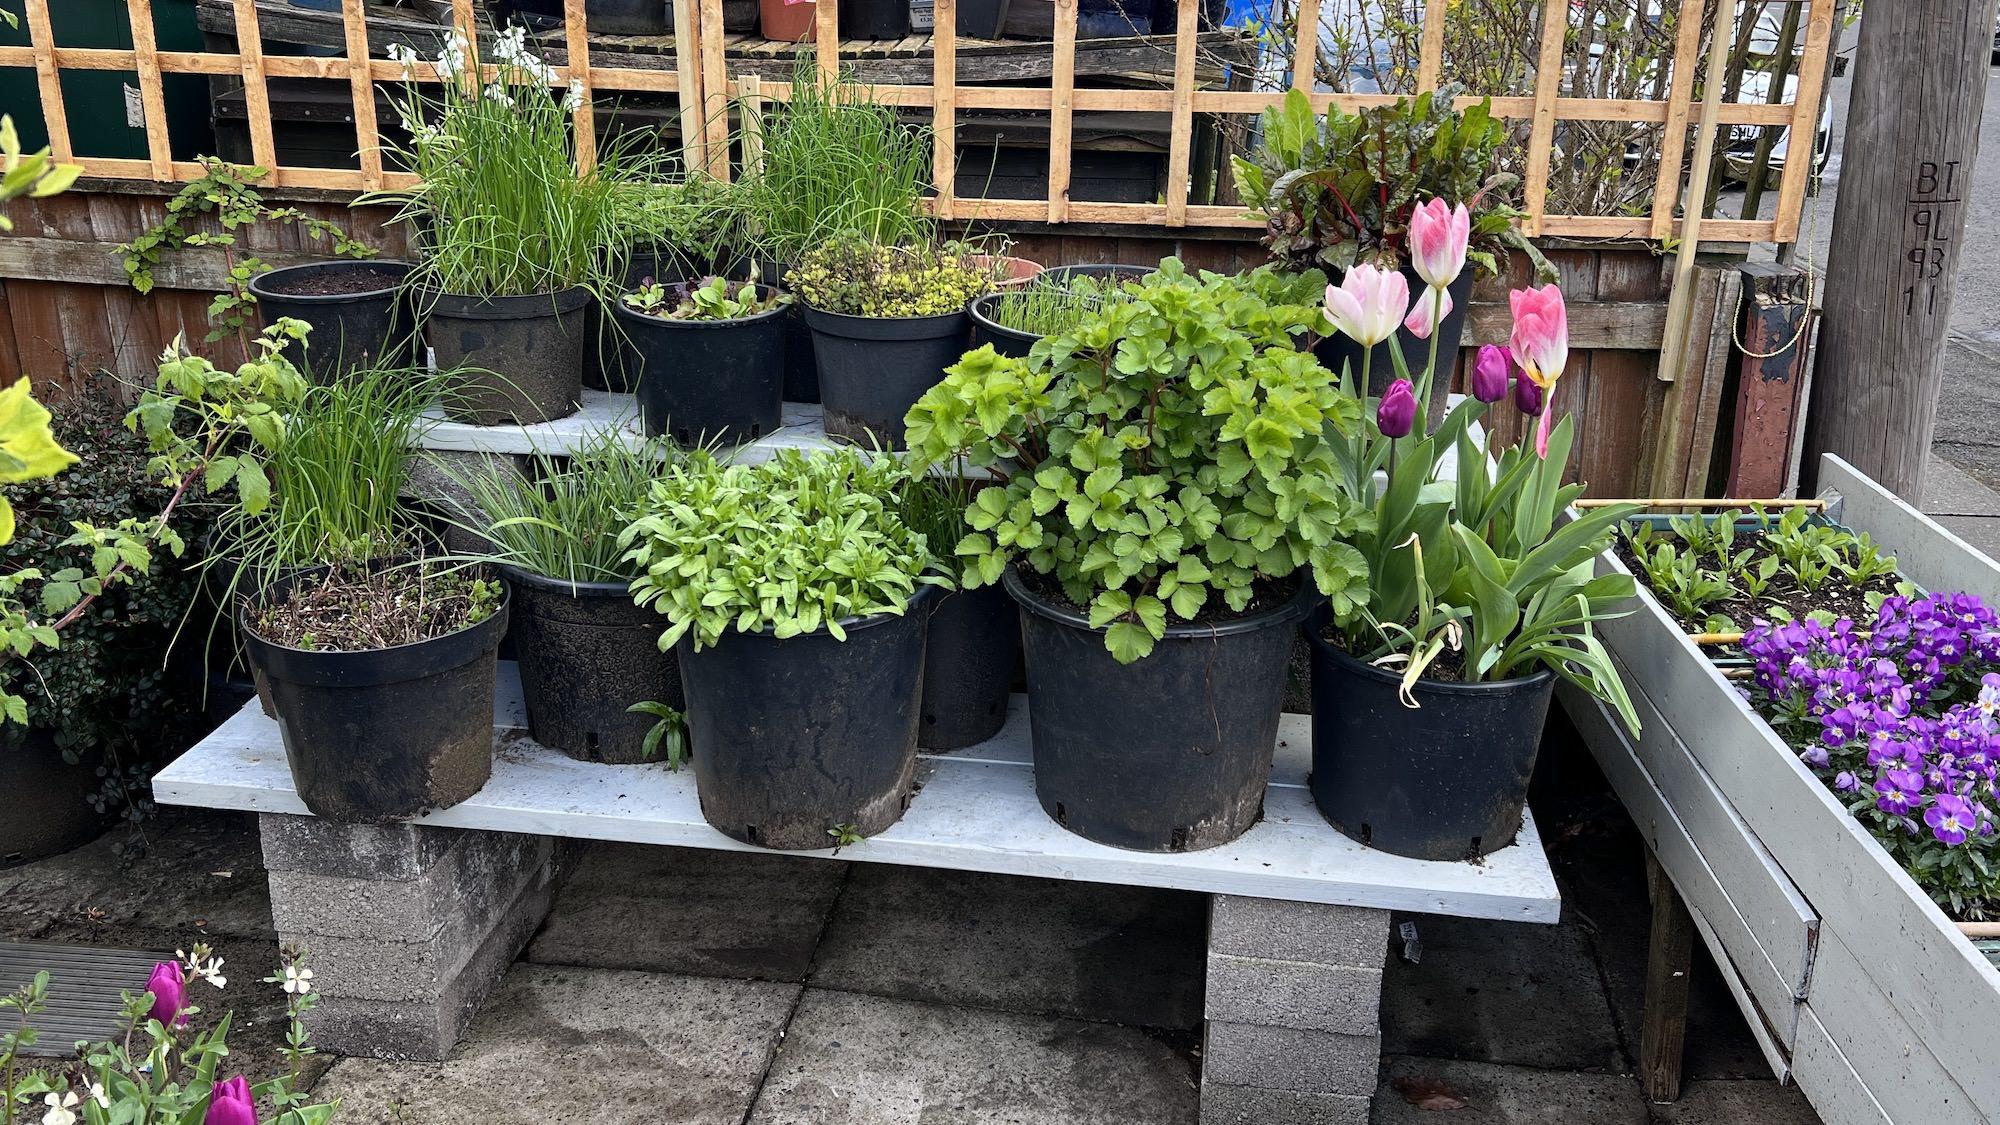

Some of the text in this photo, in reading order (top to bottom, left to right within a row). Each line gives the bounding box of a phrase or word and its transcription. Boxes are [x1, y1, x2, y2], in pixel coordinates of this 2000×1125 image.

[1917, 162, 1960, 194] BT
[1913, 210, 1949, 241] 9L
[1907, 248, 1946, 279] 93
